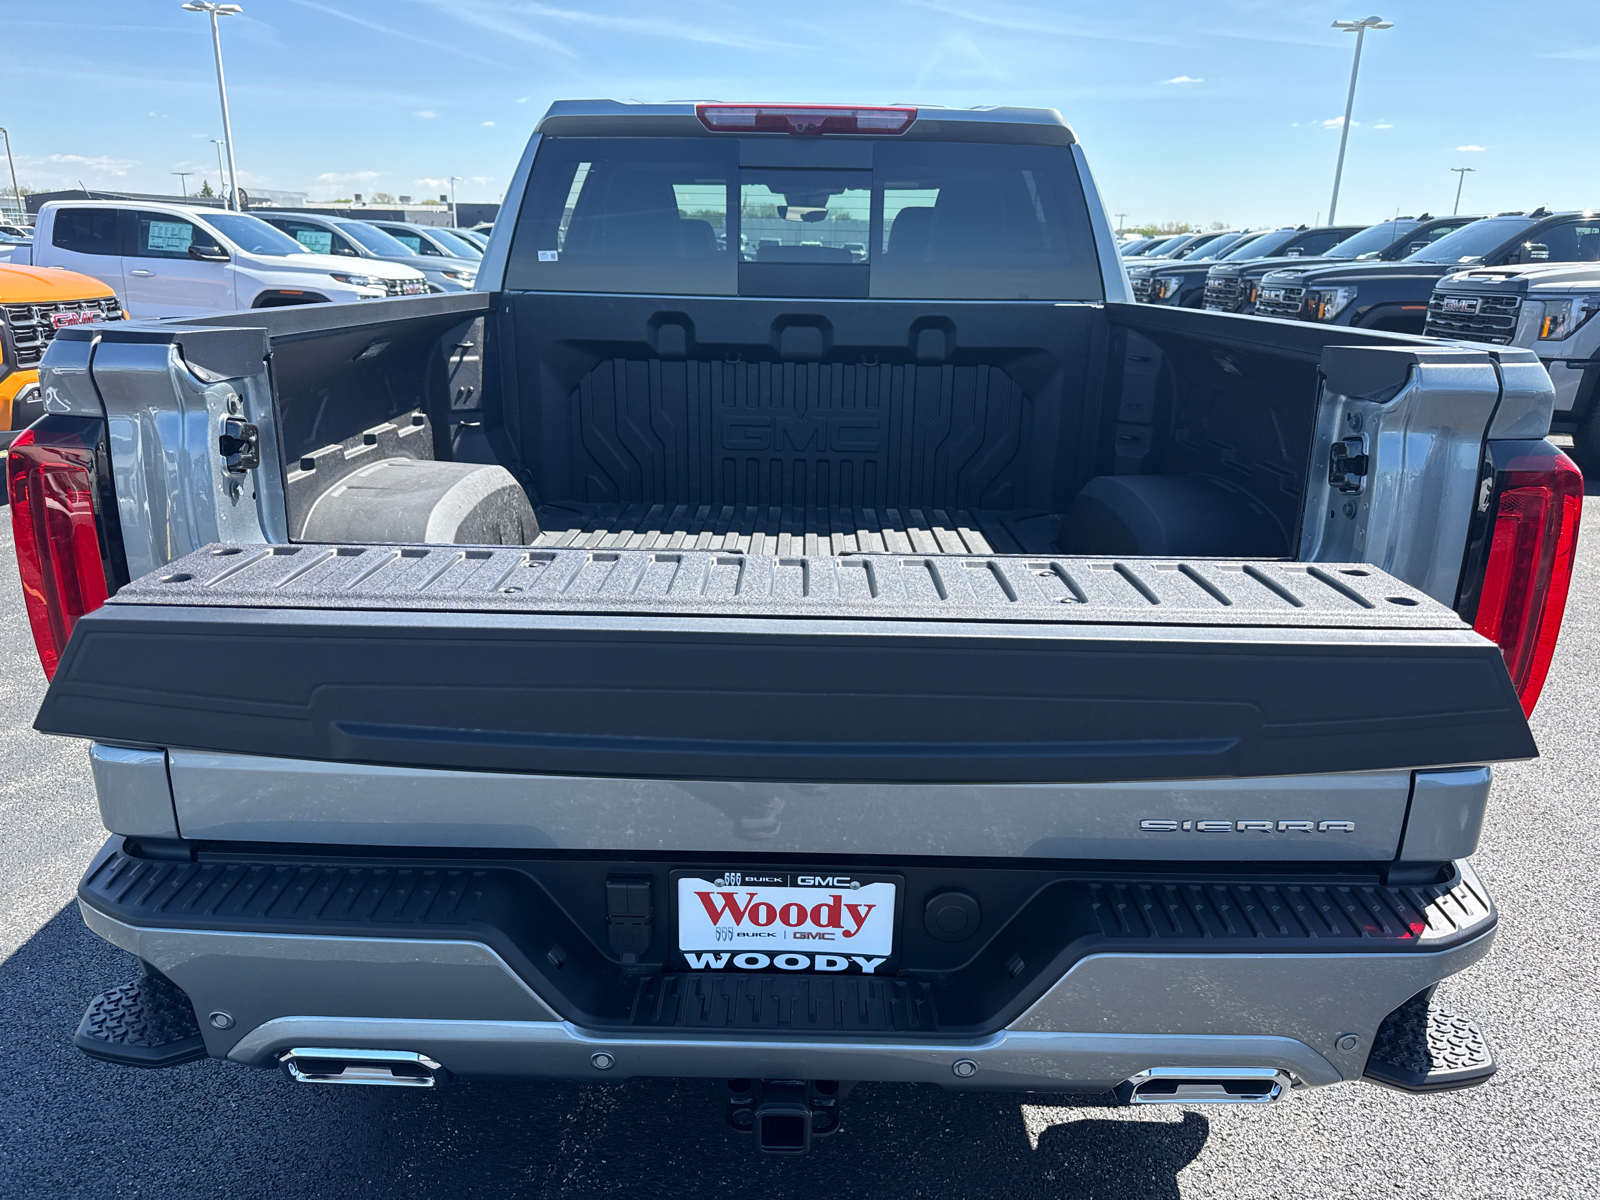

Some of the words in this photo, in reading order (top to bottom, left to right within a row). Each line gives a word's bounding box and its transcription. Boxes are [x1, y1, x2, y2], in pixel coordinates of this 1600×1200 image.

[1443, 299, 1477, 313] GMC
[52, 310, 103, 329] GMC
[719, 415, 881, 453] GMC
[1139, 818, 1356, 833] SIERRA
[797, 876, 851, 887] GMC
[693, 891, 877, 939] Woody
[793, 931, 836, 941] GMC
[683, 952, 887, 974] WOODY
